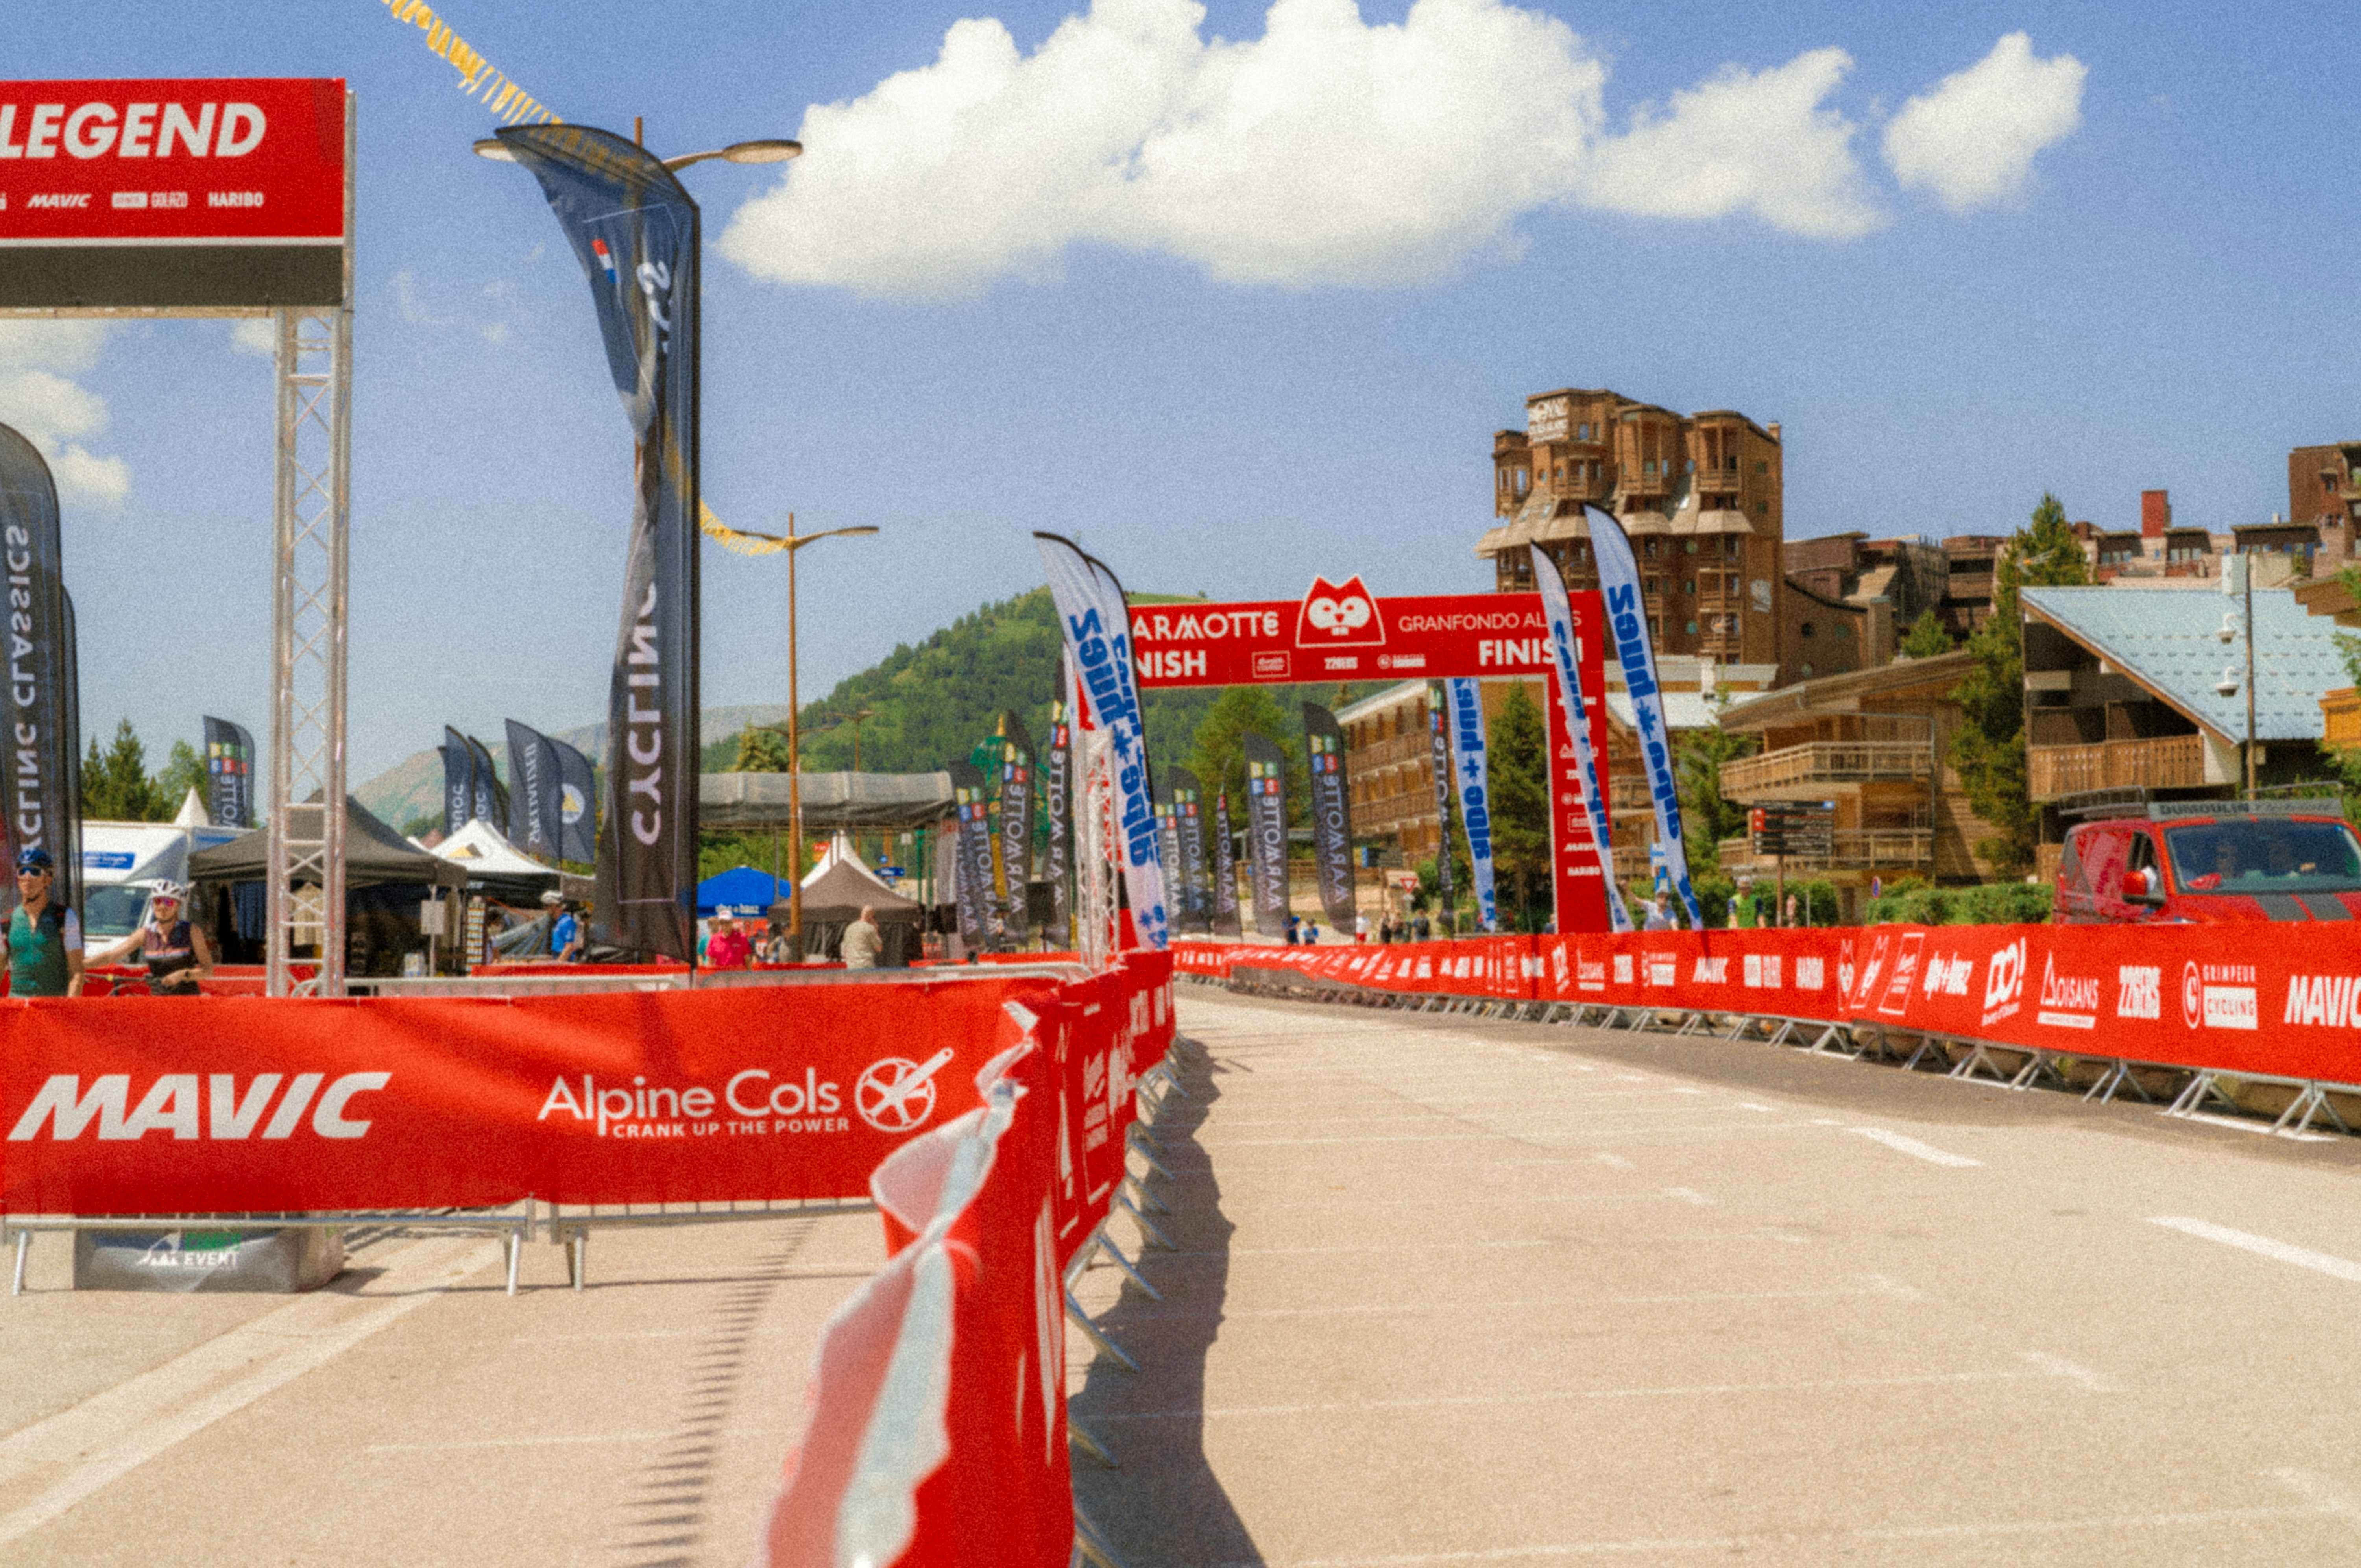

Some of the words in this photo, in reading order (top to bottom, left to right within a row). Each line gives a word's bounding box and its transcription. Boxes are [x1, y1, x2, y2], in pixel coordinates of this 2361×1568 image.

[0, 103, 266, 158] LEGEND
[27, 194, 91, 207] MAVIC
[208, 192, 264, 208] HARIBO
[1134, 611, 1279, 641] ARMOTTE
[1398, 612, 1519, 632] GRANFONDO
[1523, 609, 1582, 628] ALS
[1136, 650, 1206, 678] NISH
[6, 1072, 393, 1141] MAVIC
[538, 1074, 715, 1136] Alpine
[726, 1067, 841, 1116] Cols
[613, 1124, 685, 1138] CRANK
[693, 1122, 719, 1136] UP
[726, 1120, 767, 1135] THE
[774, 1117, 850, 1133] POWER
[184, 1251, 239, 1266] EVENT
